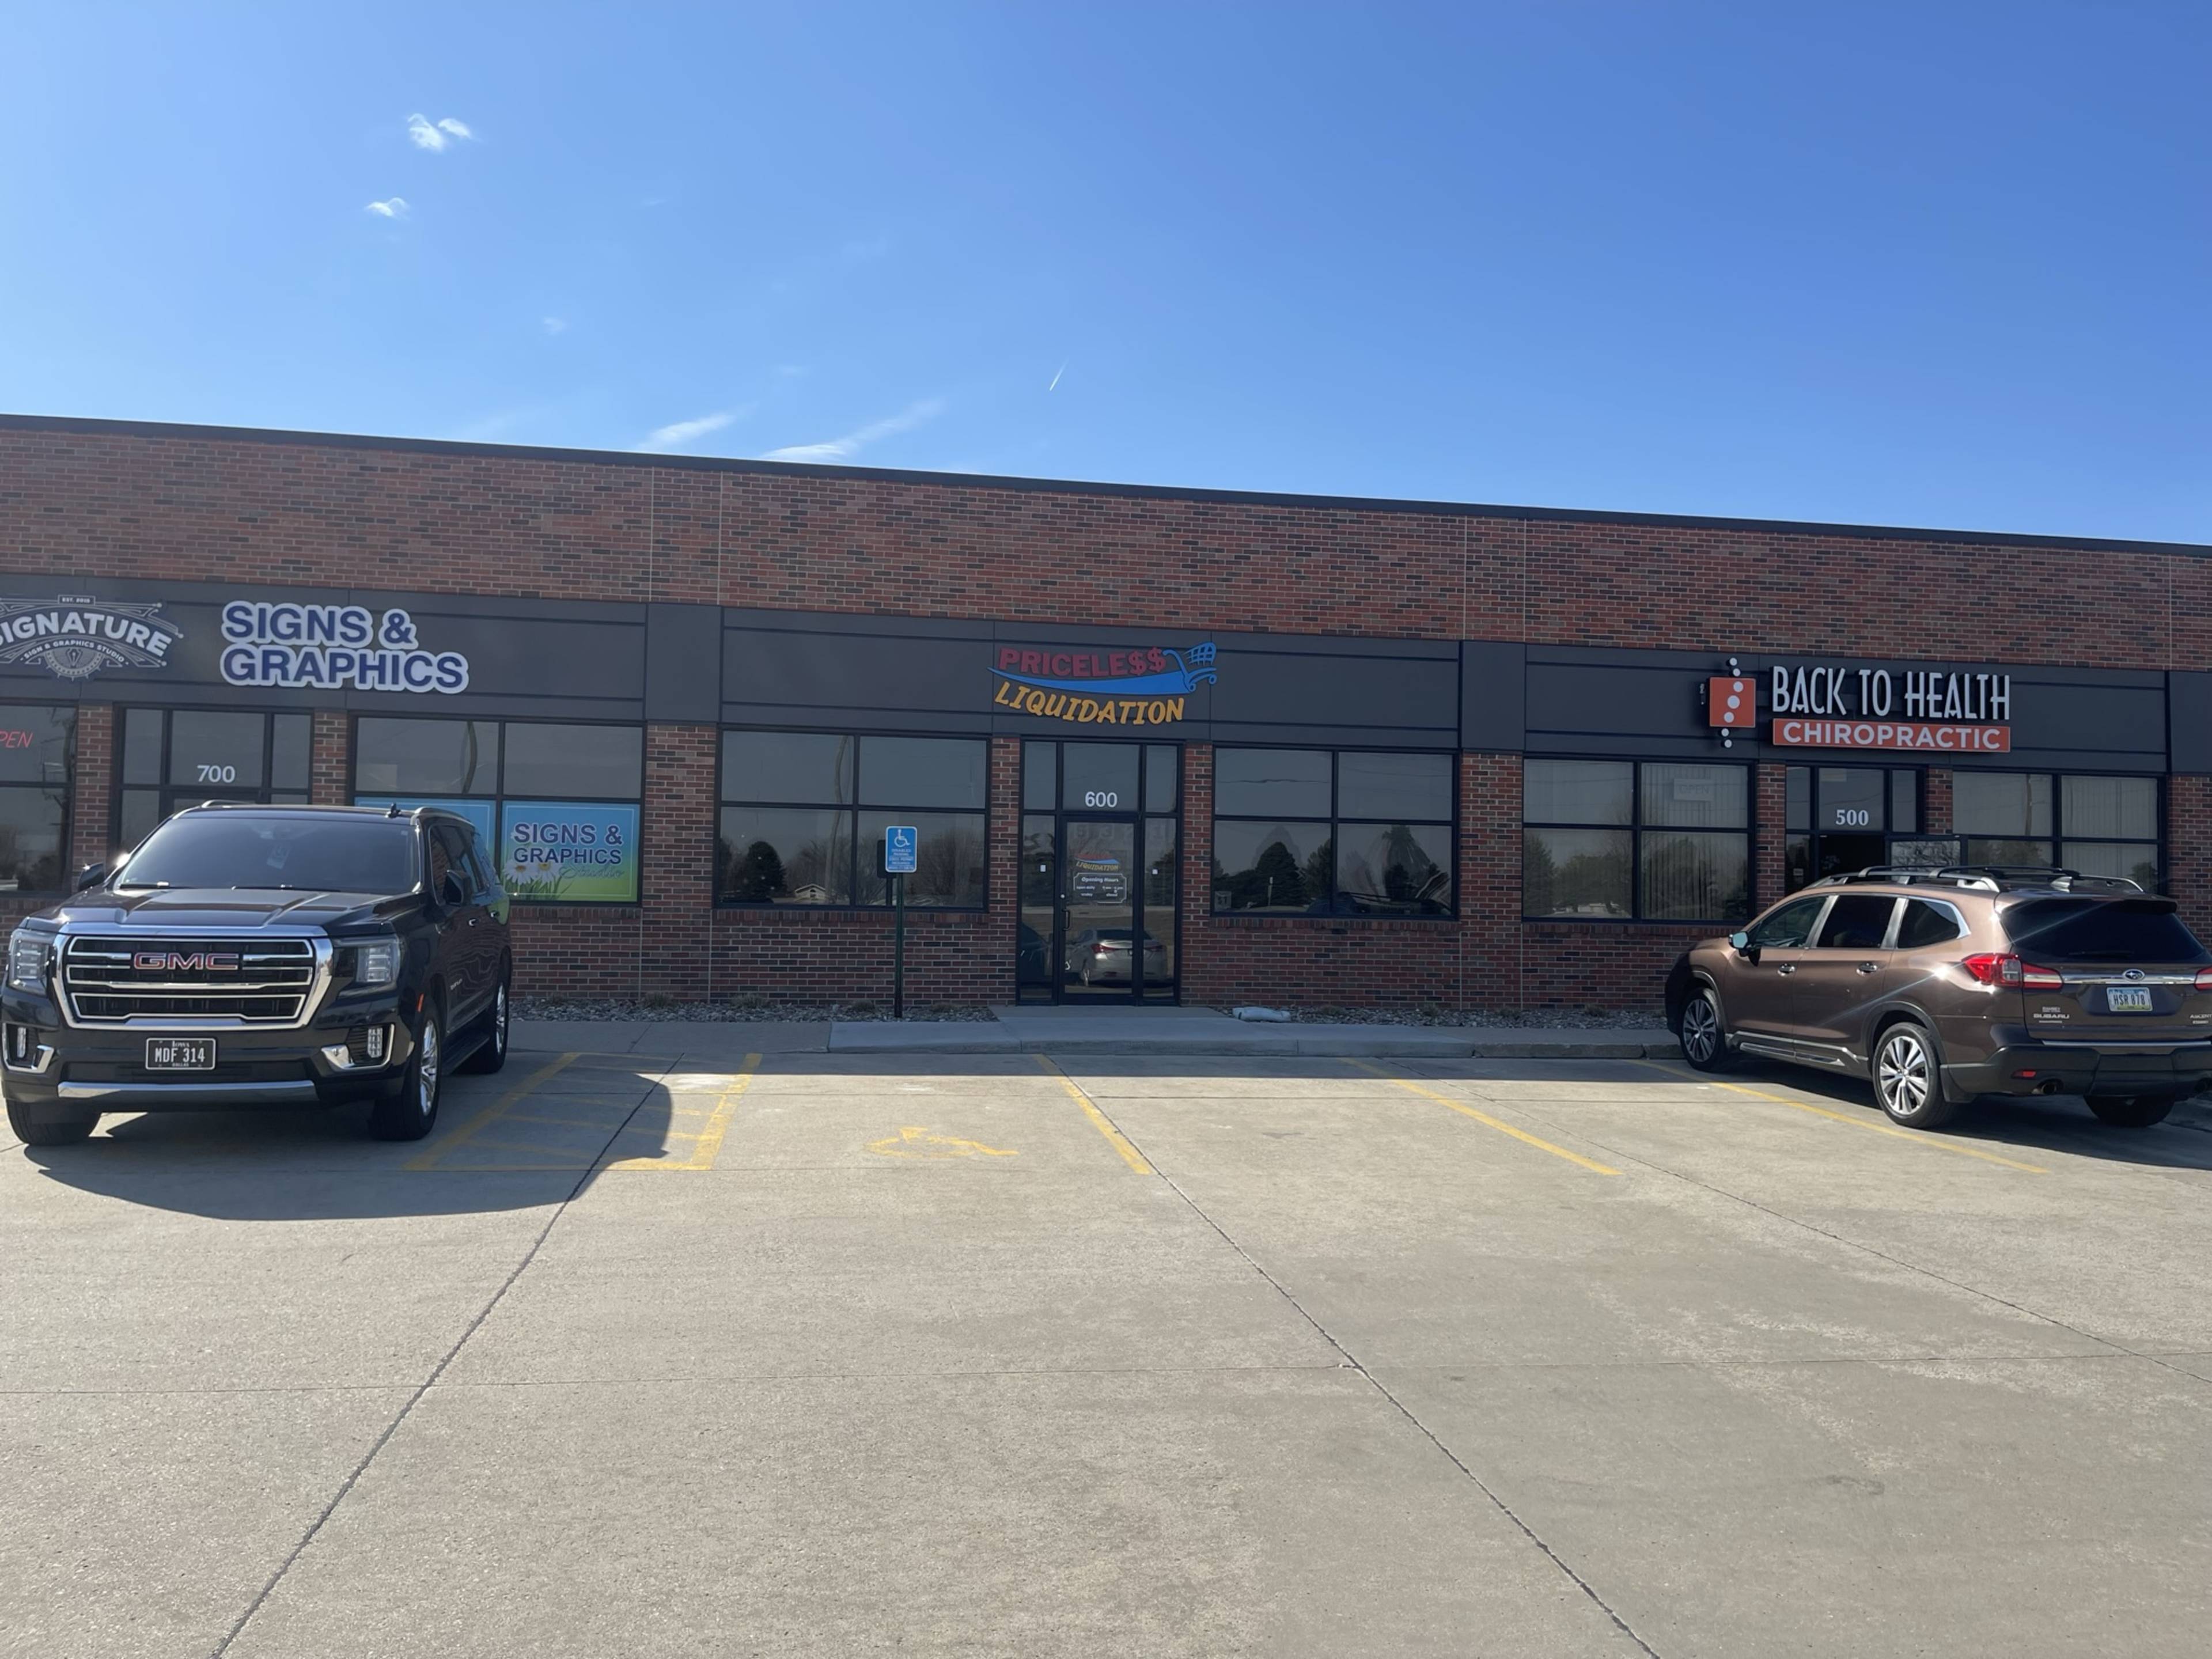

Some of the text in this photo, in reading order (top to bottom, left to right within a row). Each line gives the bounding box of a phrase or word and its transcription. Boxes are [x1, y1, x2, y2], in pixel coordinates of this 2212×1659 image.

[0, 612, 172, 657] IGNATURE
[223, 602, 416, 647] SIGNS &
[24, 646, 43, 658] SIGN
[53, 640, 94, 648] GRAPHICS
[97, 643, 124, 662] STUDIO
[222, 646, 465, 691] GRAPHICS
[999, 647, 1166, 676] PRICELE$$
[1772, 665, 2009, 720] BACK TO HEALTH
[995, 681, 1184, 725] LIQUIDATION
[0, 730, 33, 748] PEN
[1783, 722, 2000, 749] CHIROPRACTIC
[198, 765, 236, 783] 700
[1085, 791, 1118, 808] 600
[1836, 809, 1869, 826] 500
[514, 823, 623, 845] SIGNS &
[513, 847, 622, 865] GRAPHICS
[1076, 861, 1119, 871] LIQUIDATION
[558, 865, 625, 879] Studio
[134, 952, 239, 970] GMC
[155, 1047, 205, 1062] MDF 314
